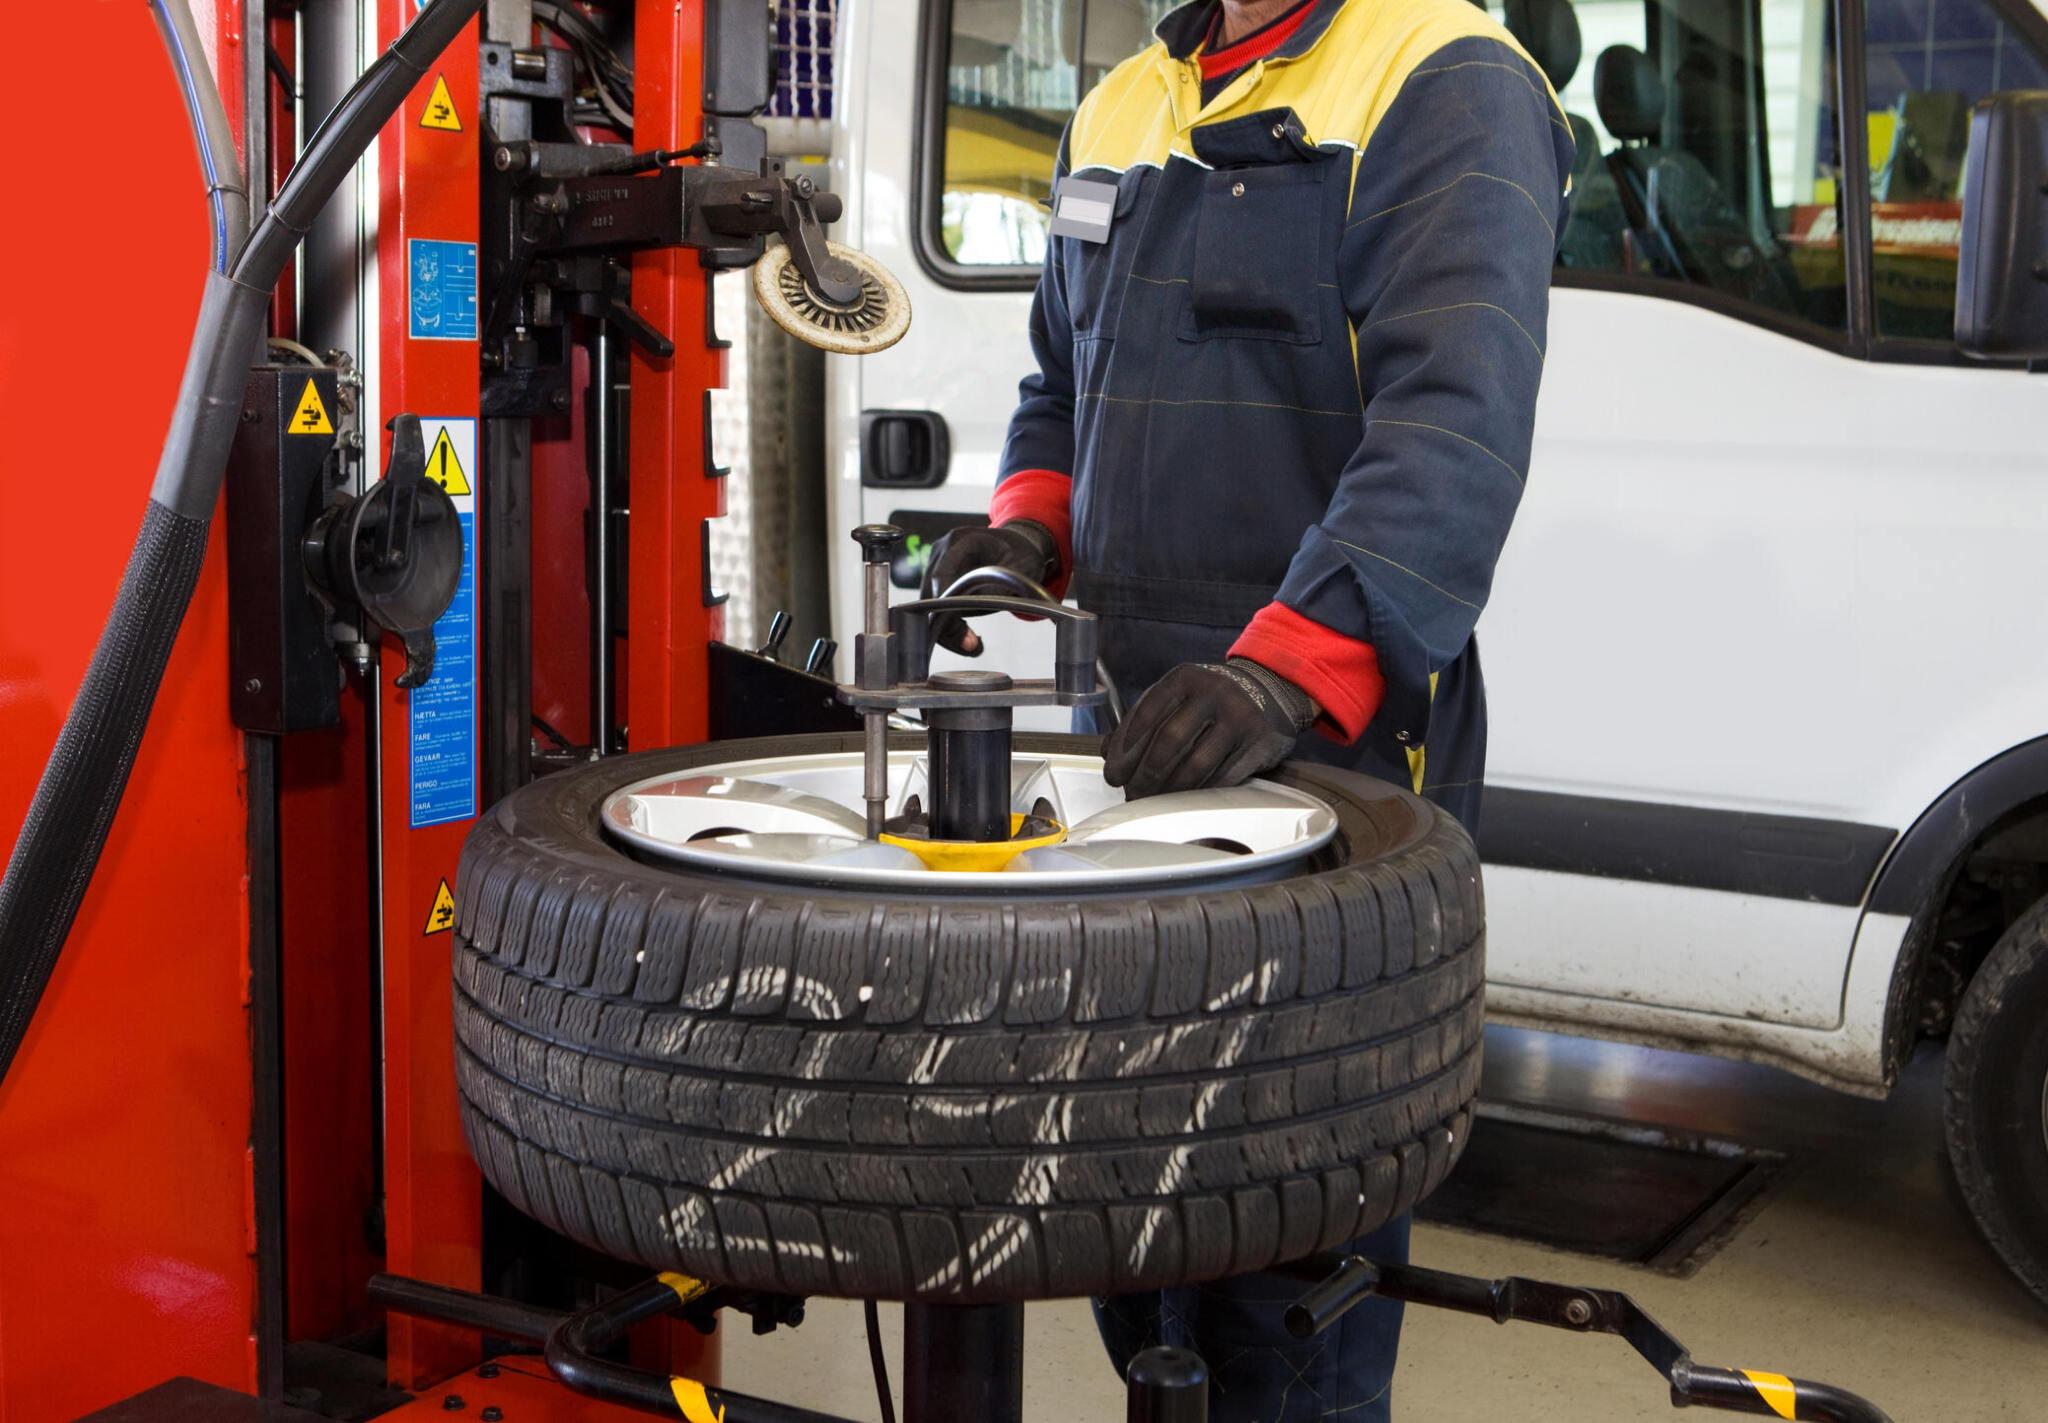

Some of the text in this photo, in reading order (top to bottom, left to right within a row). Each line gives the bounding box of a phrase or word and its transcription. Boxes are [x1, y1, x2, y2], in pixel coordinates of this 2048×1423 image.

[414, 733, 431, 741] FARE
[414, 752, 441, 763] GEVAAR
[414, 779, 438, 790] PERIGO
[414, 802, 431, 811] FARA
